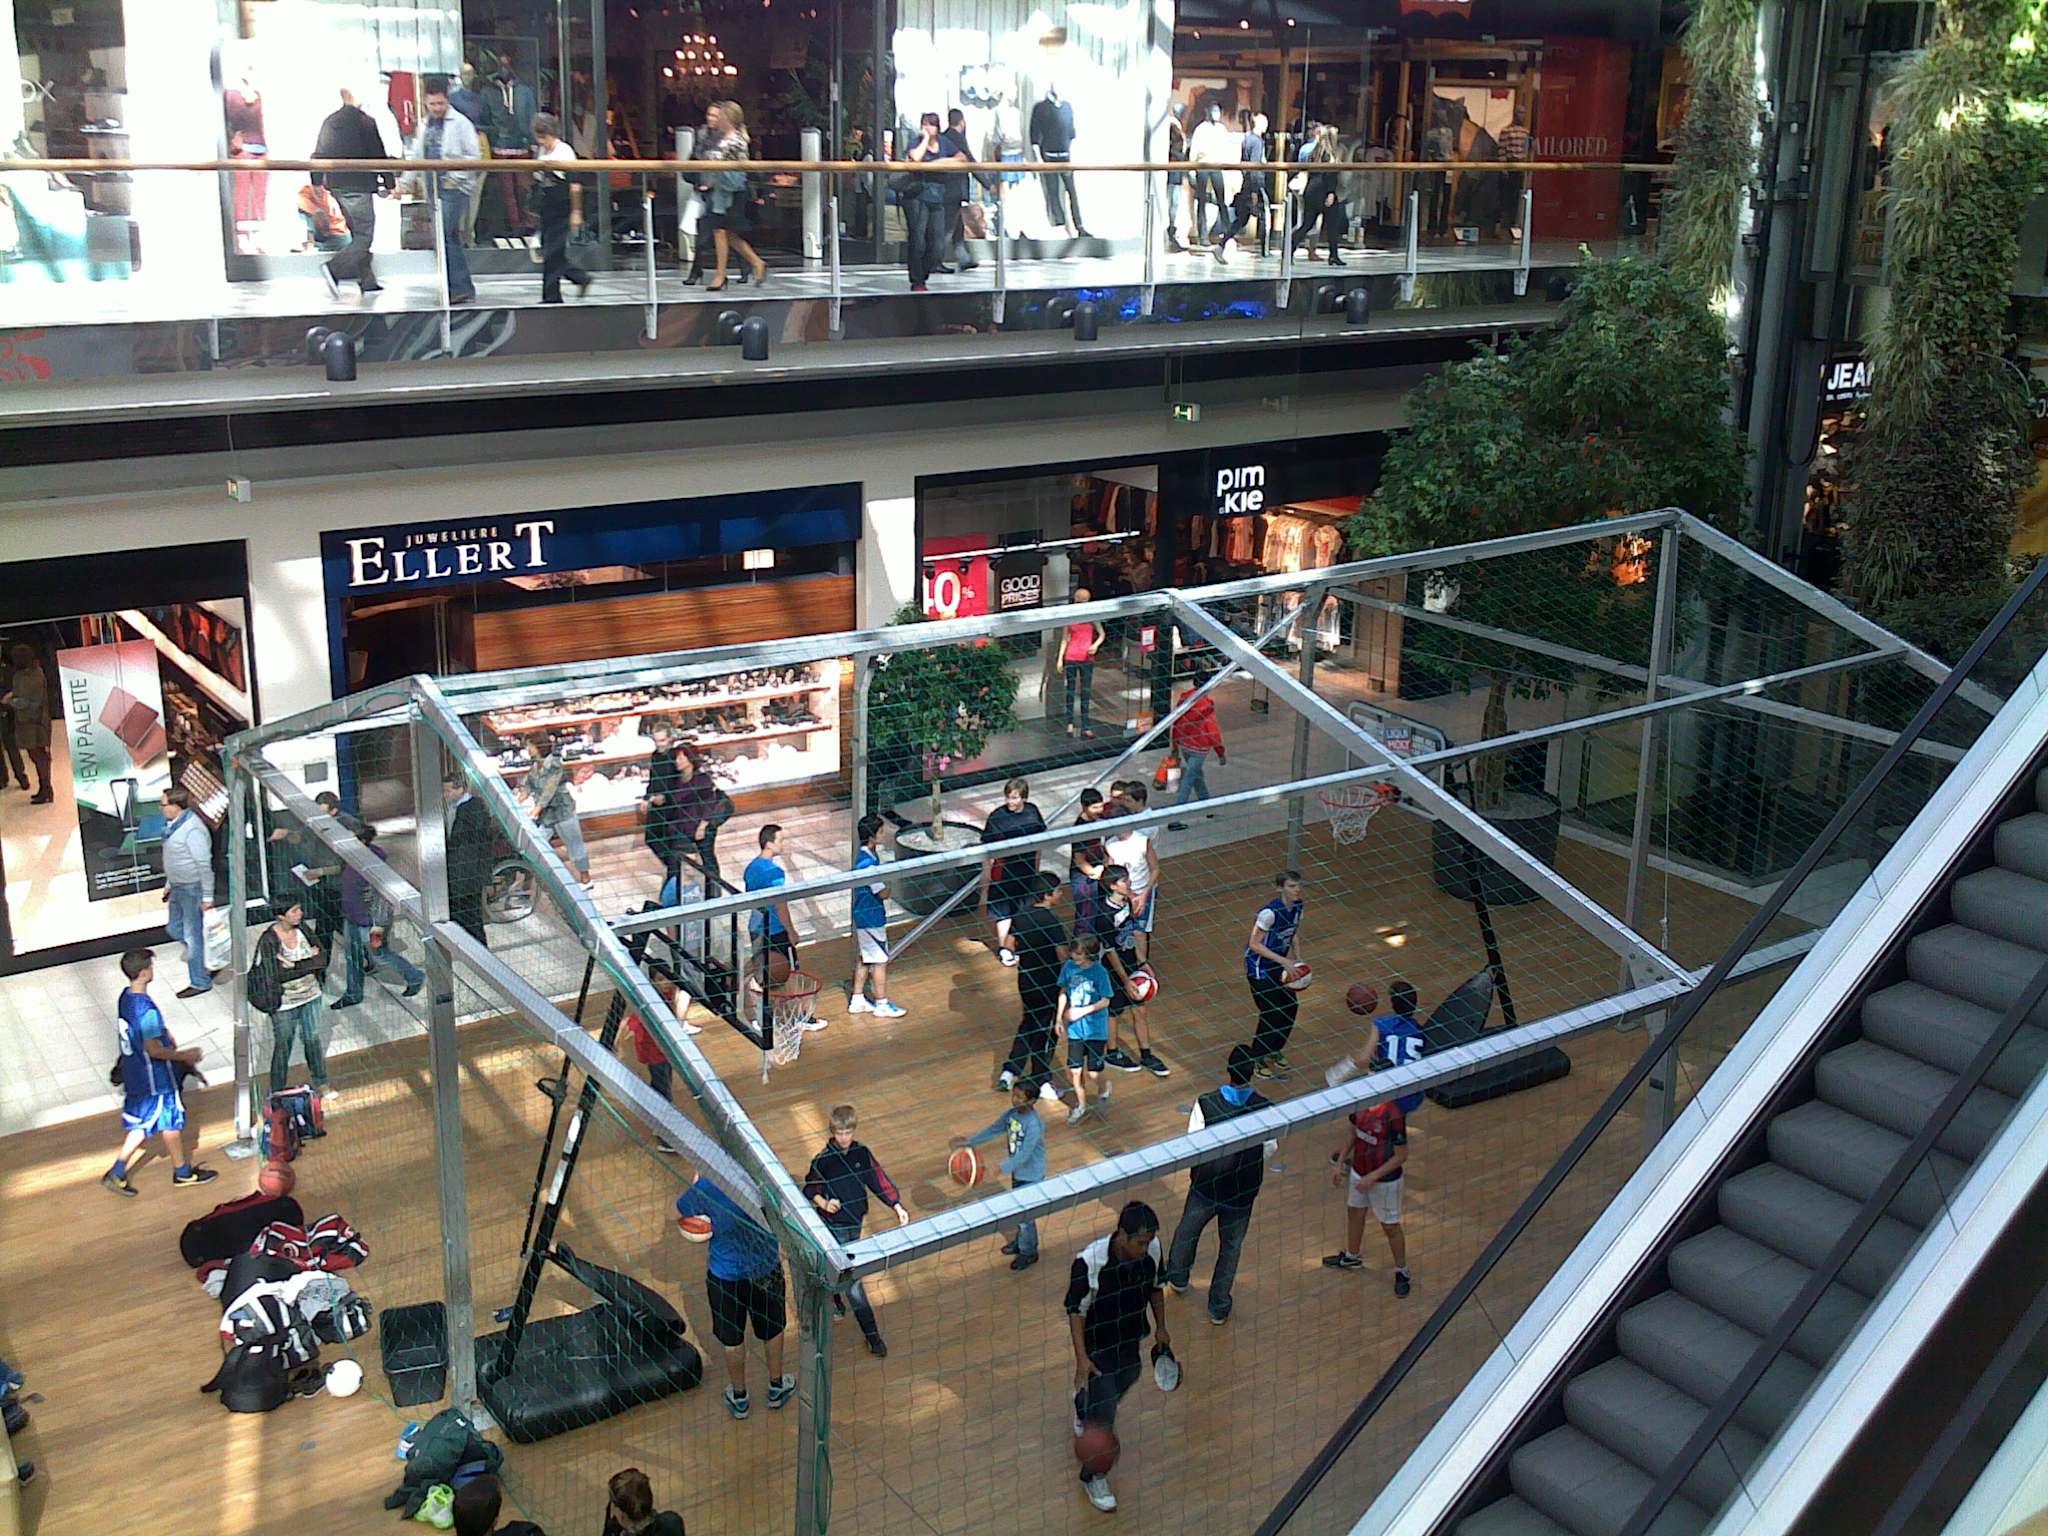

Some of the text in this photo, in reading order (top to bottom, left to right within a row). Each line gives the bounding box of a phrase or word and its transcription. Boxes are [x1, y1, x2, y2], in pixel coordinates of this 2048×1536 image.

[1217, 465, 1265, 497] pim
[405, 526, 498, 548] JUWELIERE
[345, 520, 555, 587] ELLERT
[1001, 574, 1040, 593] GOOD
[1001, 588, 1040, 606] PRICES
[70, 678, 98, 793] NEW PALETTE
[1386, 1034, 1424, 1067] 15
